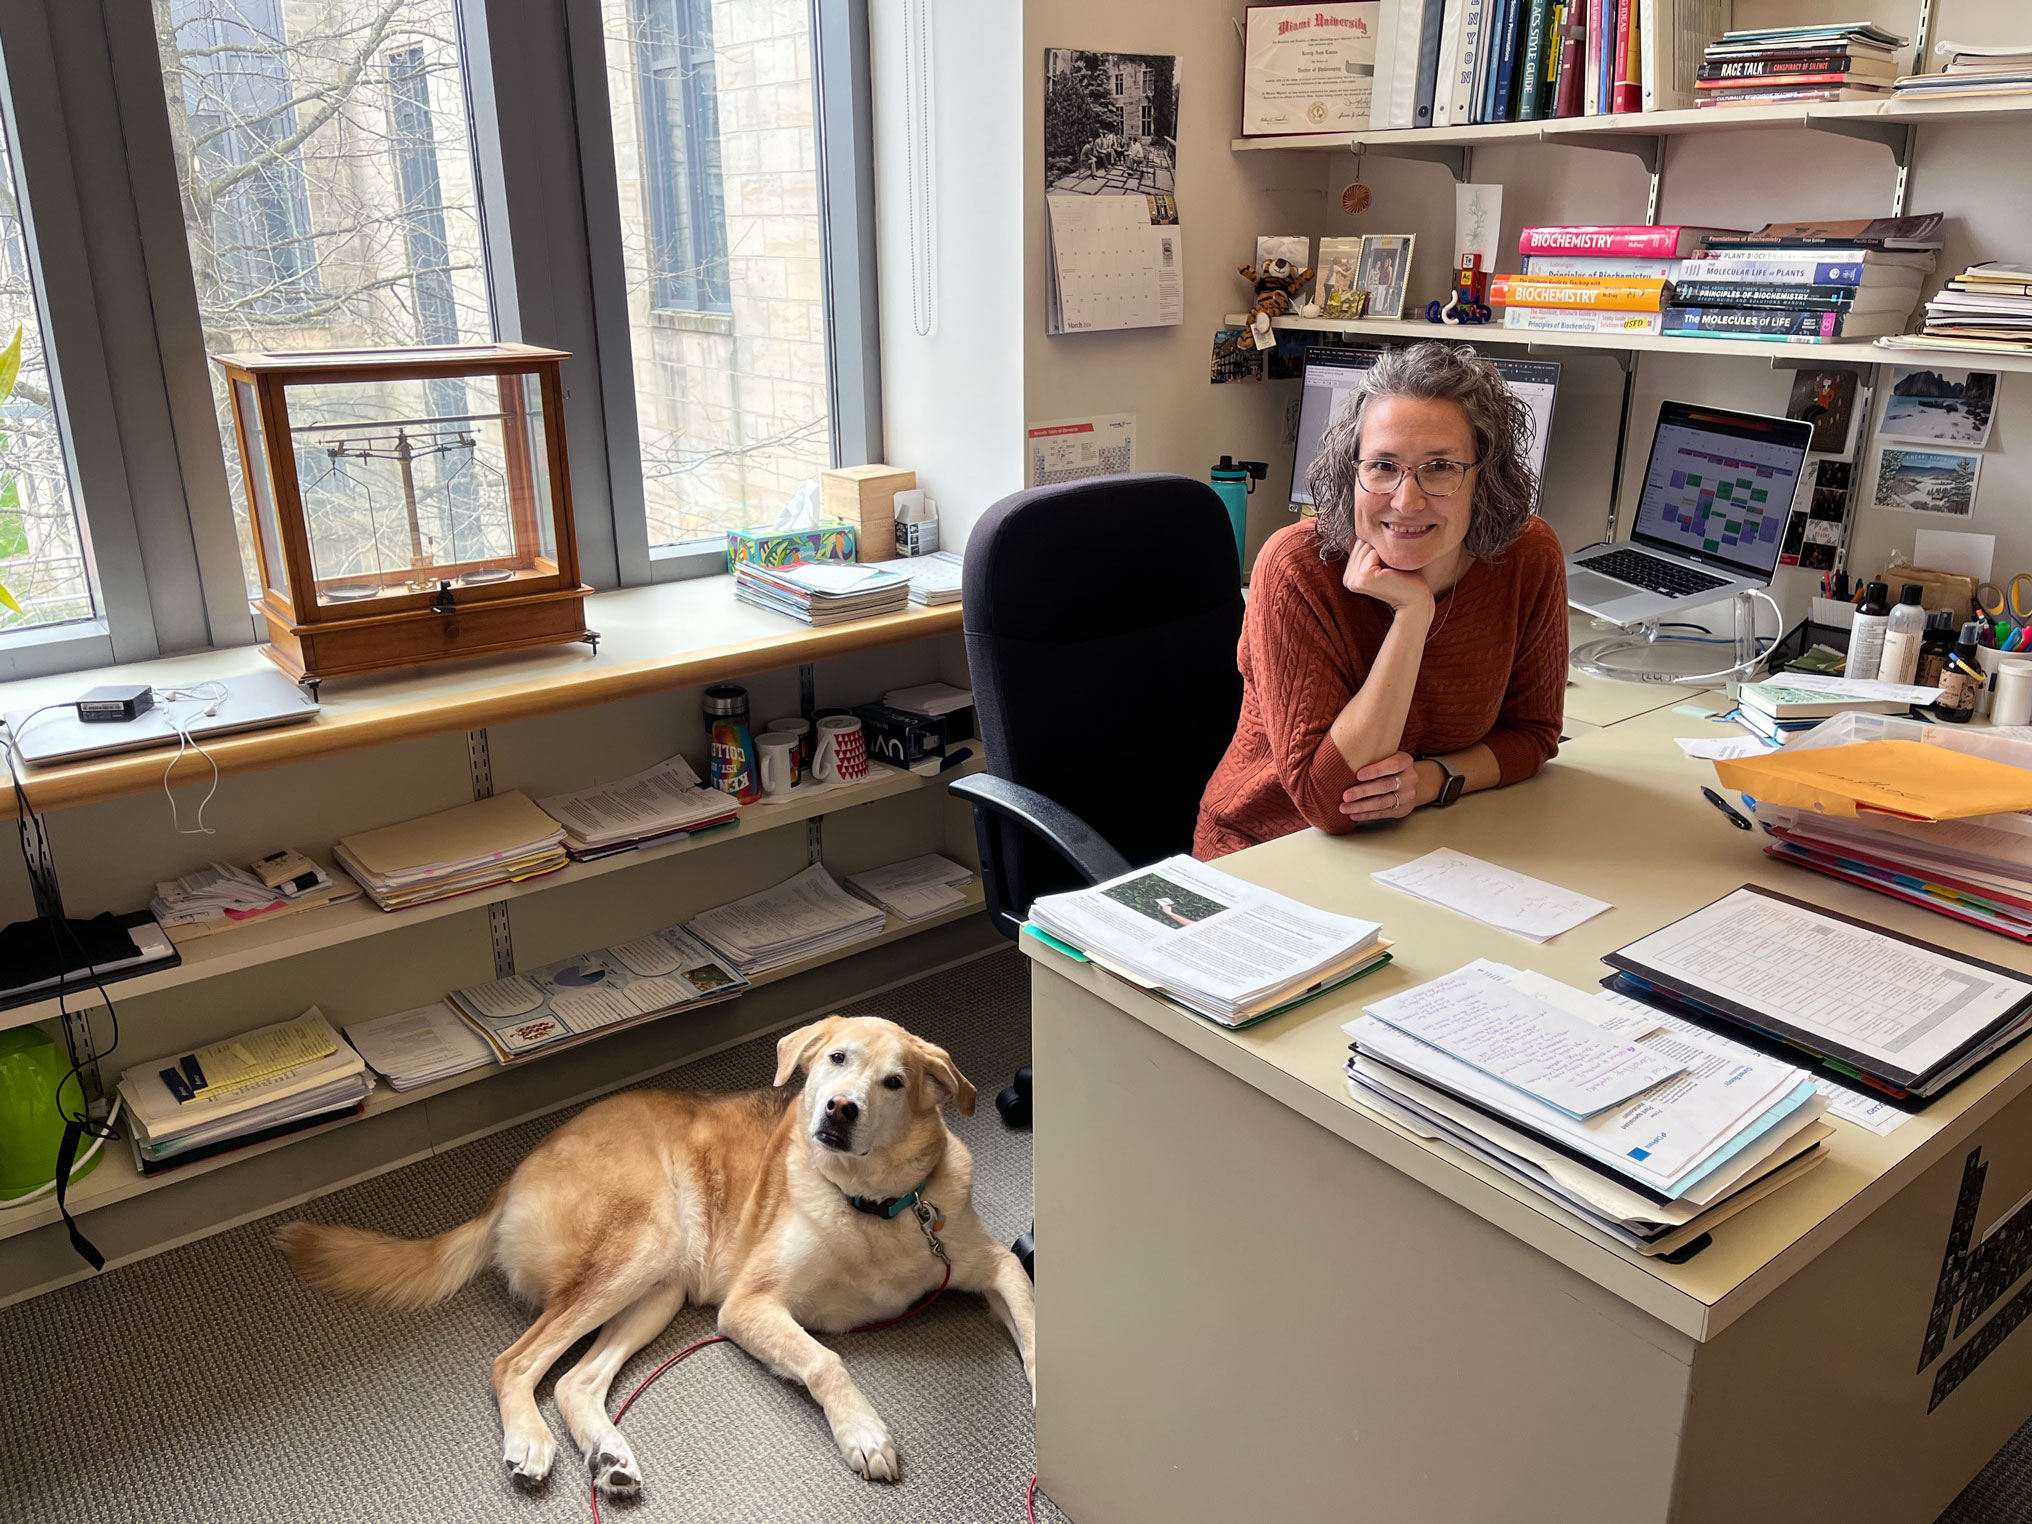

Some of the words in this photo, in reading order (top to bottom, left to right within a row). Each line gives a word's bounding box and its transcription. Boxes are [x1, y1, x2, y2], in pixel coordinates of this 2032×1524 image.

[1278, 17, 1311, 36] Miami
[1314, 13, 1368, 35] University
[1531, 9, 1542, 27] ACS
[1504, 23, 1514, 62] Presentations
[1528, 30, 1540, 60] STYLE
[1720, 63, 1742, 76] RACE
[1743, 62, 1764, 75] TALK
[1773, 63, 1801, 72] CONSPIRACY
[1809, 62, 1829, 70] SILENCE
[1524, 64, 1536, 94] GUIDE
[1531, 233, 1614, 248] BIOCHEMISTRY
[1748, 236, 1782, 244] Biochemistry
[1724, 252, 1746, 260] PLANT
[1707, 268, 1750, 276] MOLECULAR
[1751, 268, 1767, 277] LIFE
[1776, 269, 1805, 277] PLANTS
[1515, 288, 1597, 303] BIOCHEMISTRY
[1699, 290, 1741, 299] PRINCIPLES
[1742, 291, 1752, 299] OF
[1754, 292, 1808, 301] BIOCHEMISTRY
[1528, 321, 1553, 329] Principles
[1554, 321, 1560, 329] of
[1561, 322, 1595, 331] Biochemistry
[1623, 320, 1643, 329] USED
[1685, 314, 1700, 323] The
[1702, 315, 1758, 326] MOLECULES
[1760, 316, 1770, 326] of
[1772, 317, 1791, 327] LIFE
[712, 743, 746, 762] COLLE
[719, 764, 737, 773] EST.
